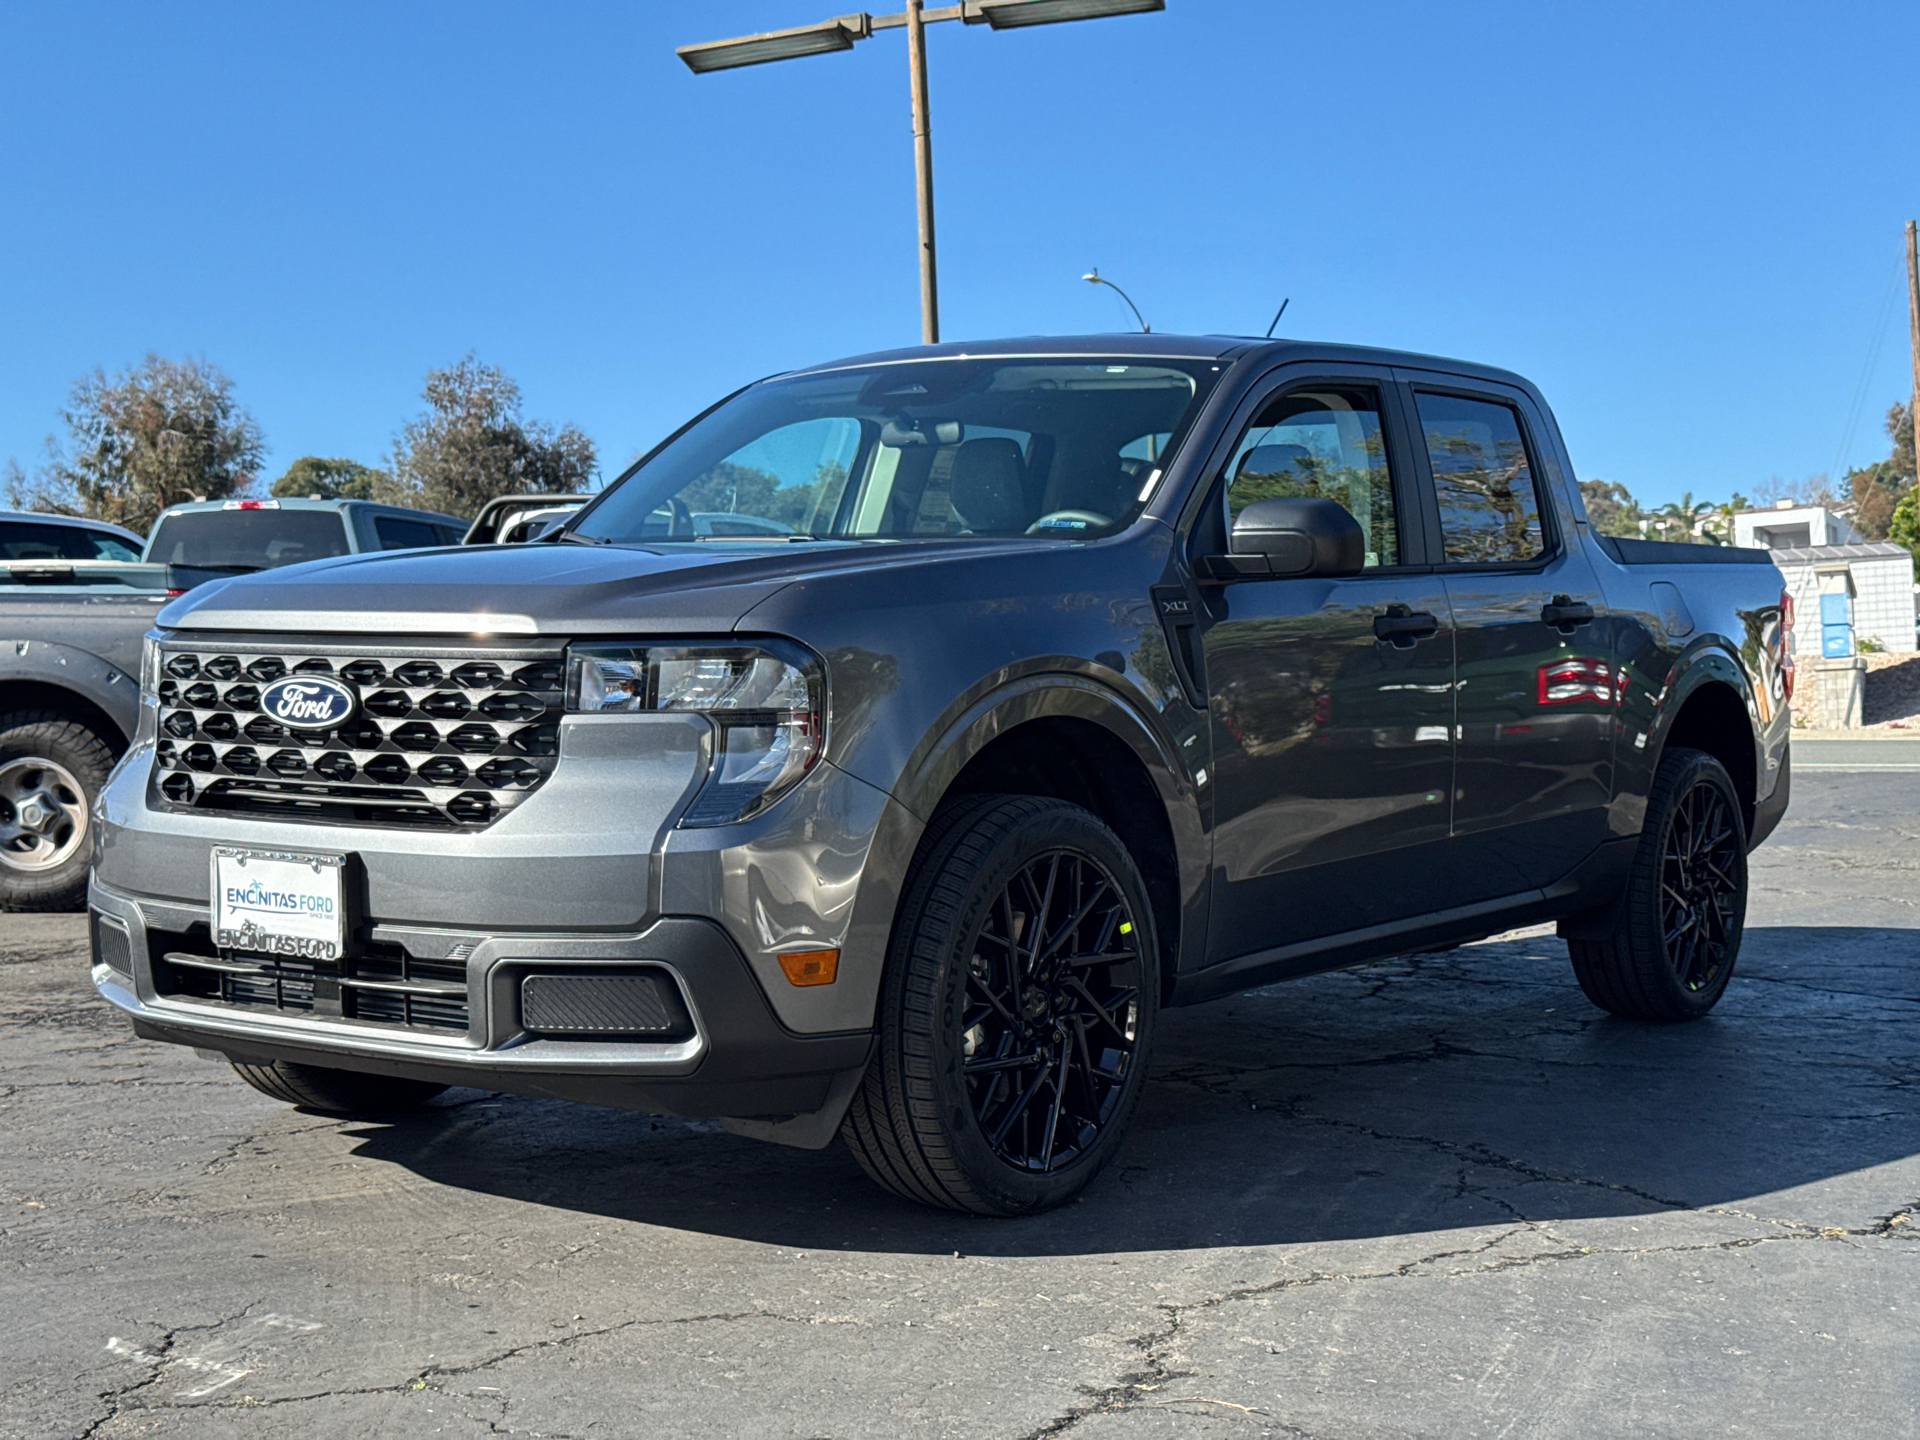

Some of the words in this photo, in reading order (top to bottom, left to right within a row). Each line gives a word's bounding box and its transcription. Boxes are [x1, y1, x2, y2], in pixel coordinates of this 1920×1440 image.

[1162, 600, 1191, 613] XLT
[276, 684, 334, 720] Ford
[227, 886, 297, 909] ENCINITAS
[299, 894, 333, 913] FORD
[216, 929, 296, 954] ENCINITAS
[298, 937, 337, 960] FORD
